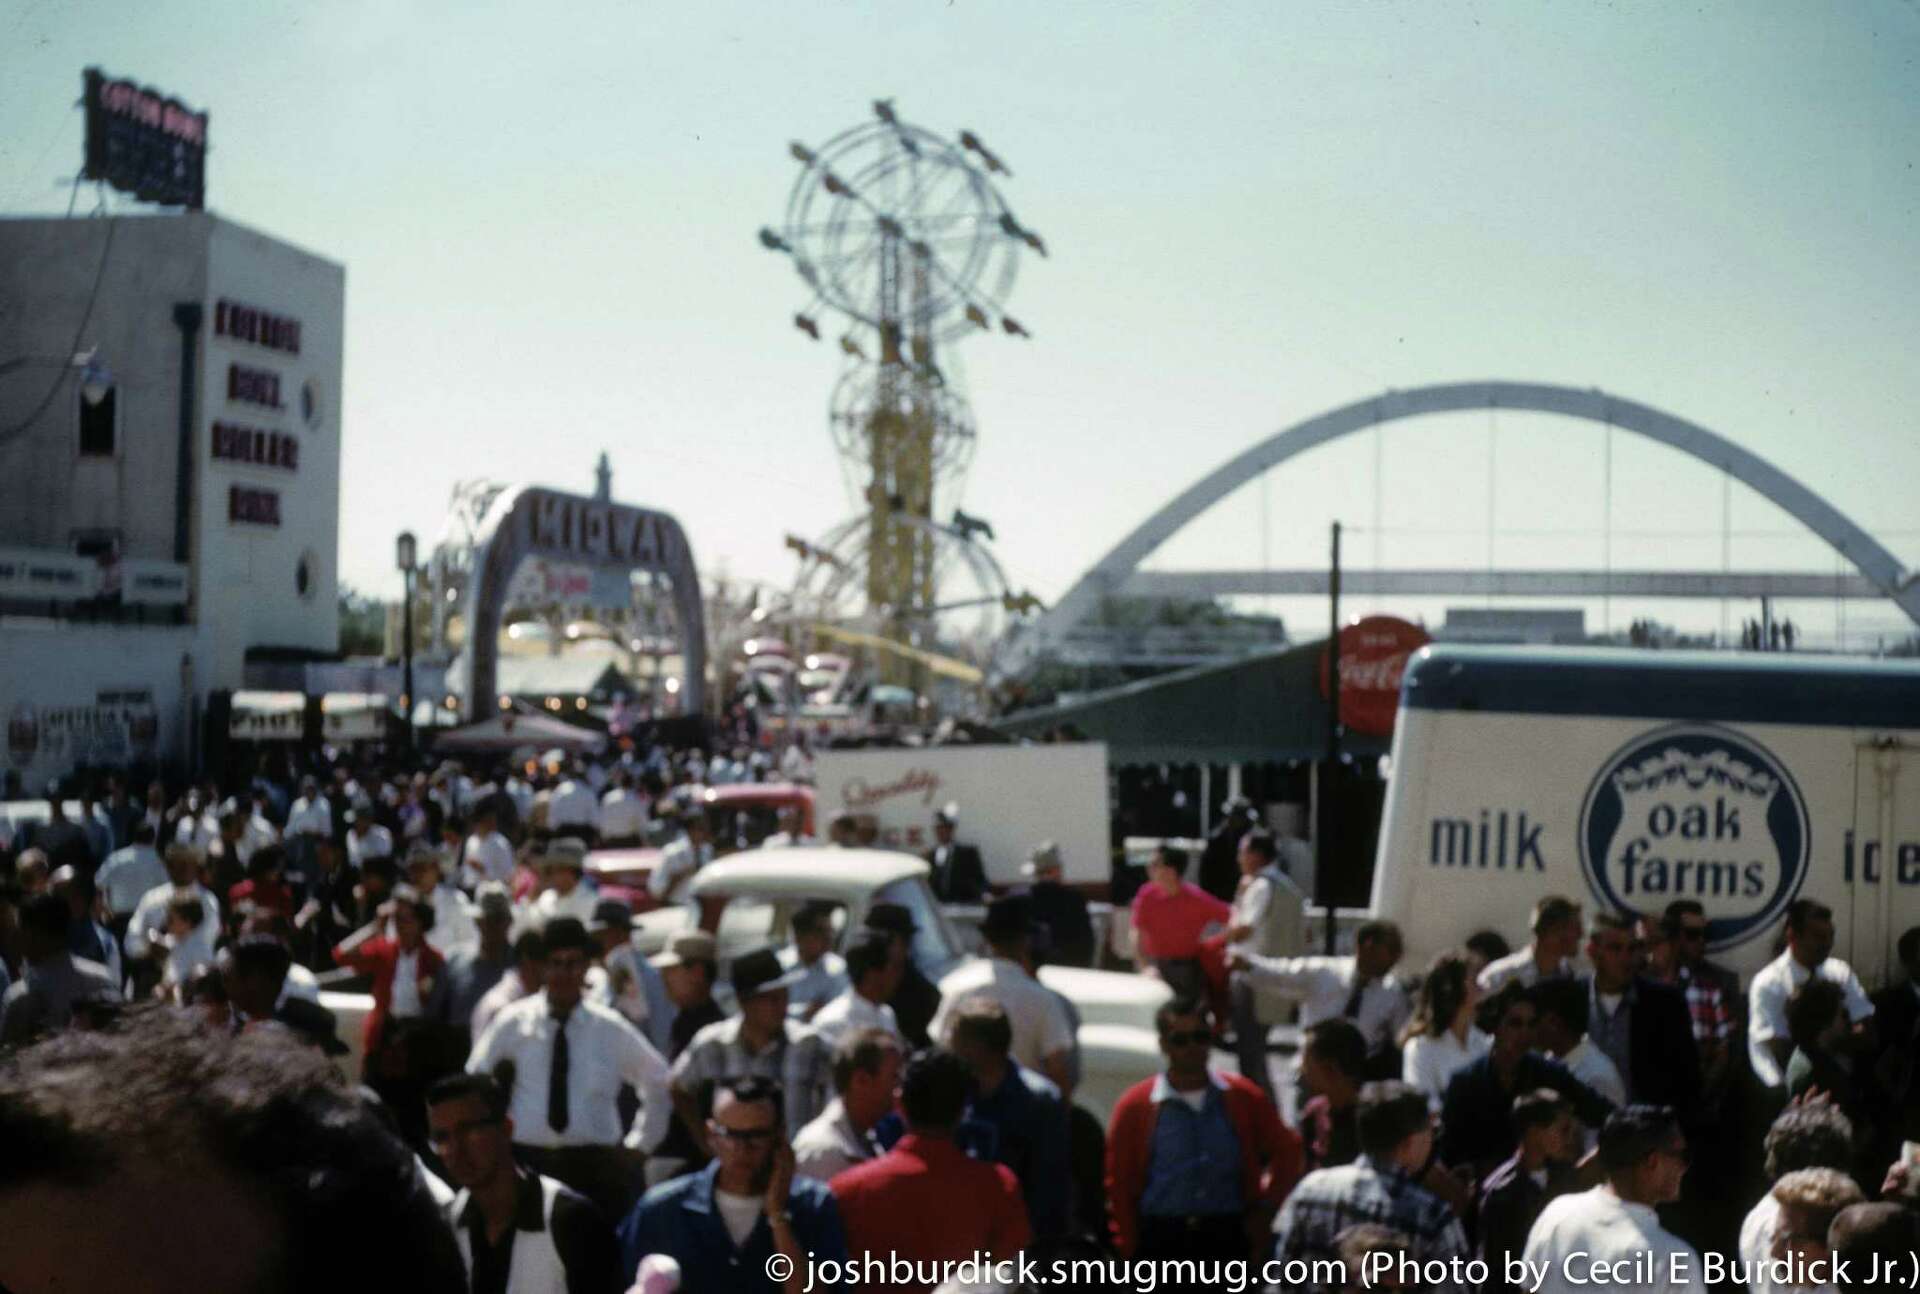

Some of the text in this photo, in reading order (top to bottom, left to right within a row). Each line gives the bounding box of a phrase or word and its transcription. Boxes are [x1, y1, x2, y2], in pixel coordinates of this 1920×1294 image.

[1430, 809, 1545, 872] milk
[1648, 796, 1741, 842] oak
[1618, 836, 1765, 896] farms
